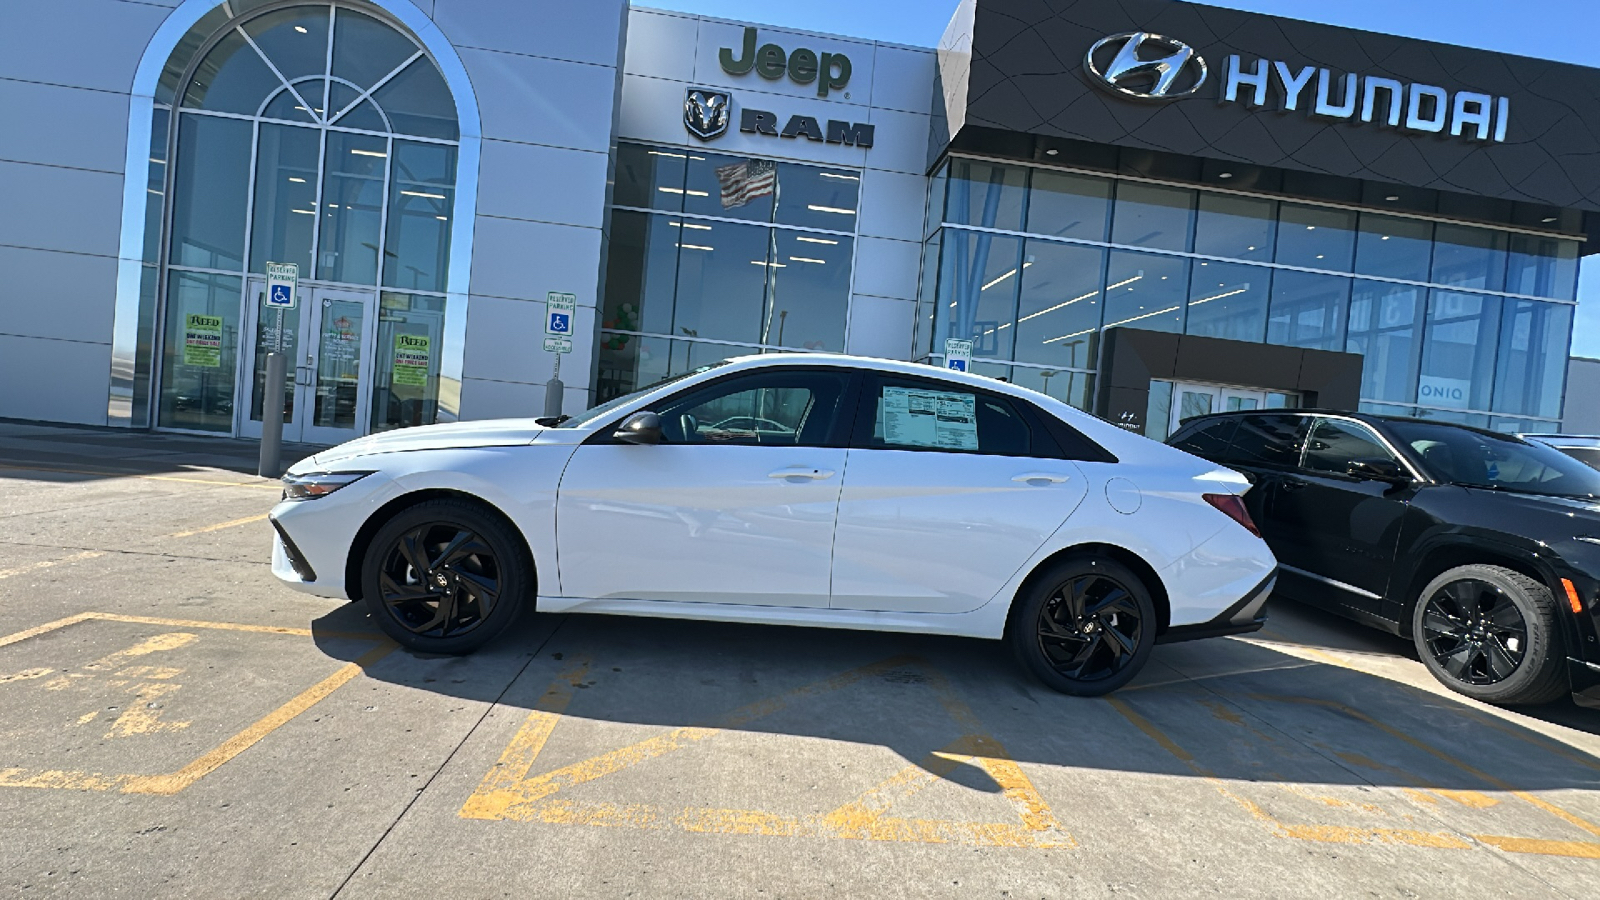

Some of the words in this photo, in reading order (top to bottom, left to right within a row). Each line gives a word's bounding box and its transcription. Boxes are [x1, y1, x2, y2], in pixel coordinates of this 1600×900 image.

[718, 26, 852, 97] Jeep
[1222, 54, 1509, 142] HYUNDAI
[740, 108, 875, 148] RAM
[269, 266, 295, 274] RESERVED
[269, 273, 295, 282] PARKING
[549, 294, 574, 303] RESERVED
[549, 302, 574, 311] PARKING
[190, 315, 219, 327] REED
[399, 335, 427, 347] REED
[947, 342, 970, 350] RESERVED
[947, 349, 970, 357] PARKING
